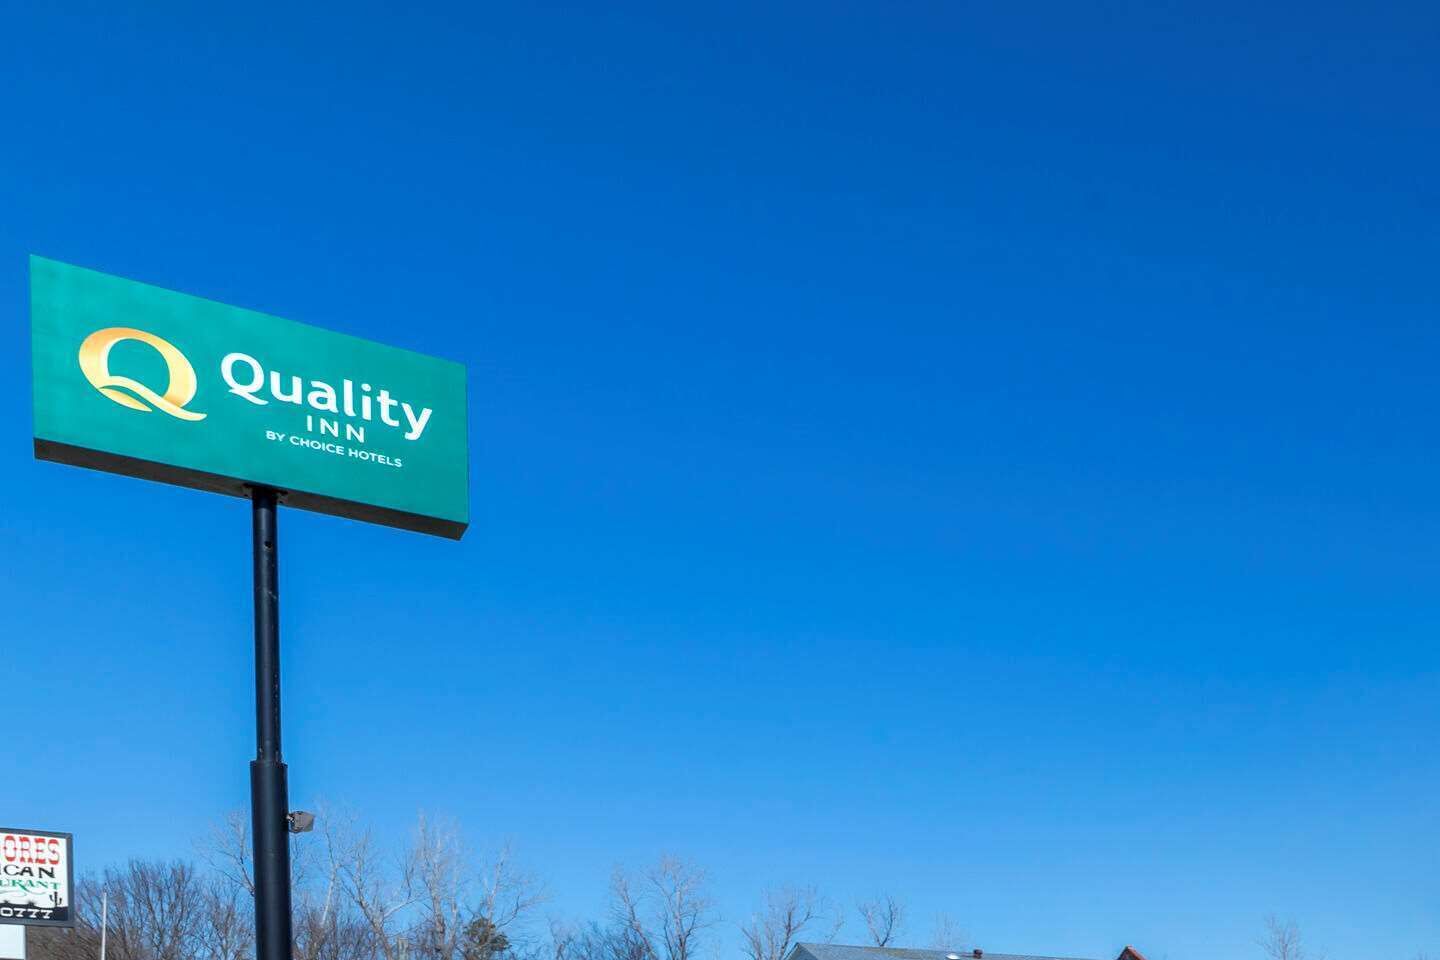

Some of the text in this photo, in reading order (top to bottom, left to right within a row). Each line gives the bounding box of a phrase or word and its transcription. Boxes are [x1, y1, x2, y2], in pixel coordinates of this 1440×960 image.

[220, 352, 433, 441] Quality
[306, 414, 365, 443] INN
[265, 430, 403, 468] BY CHOICE HOTELS
